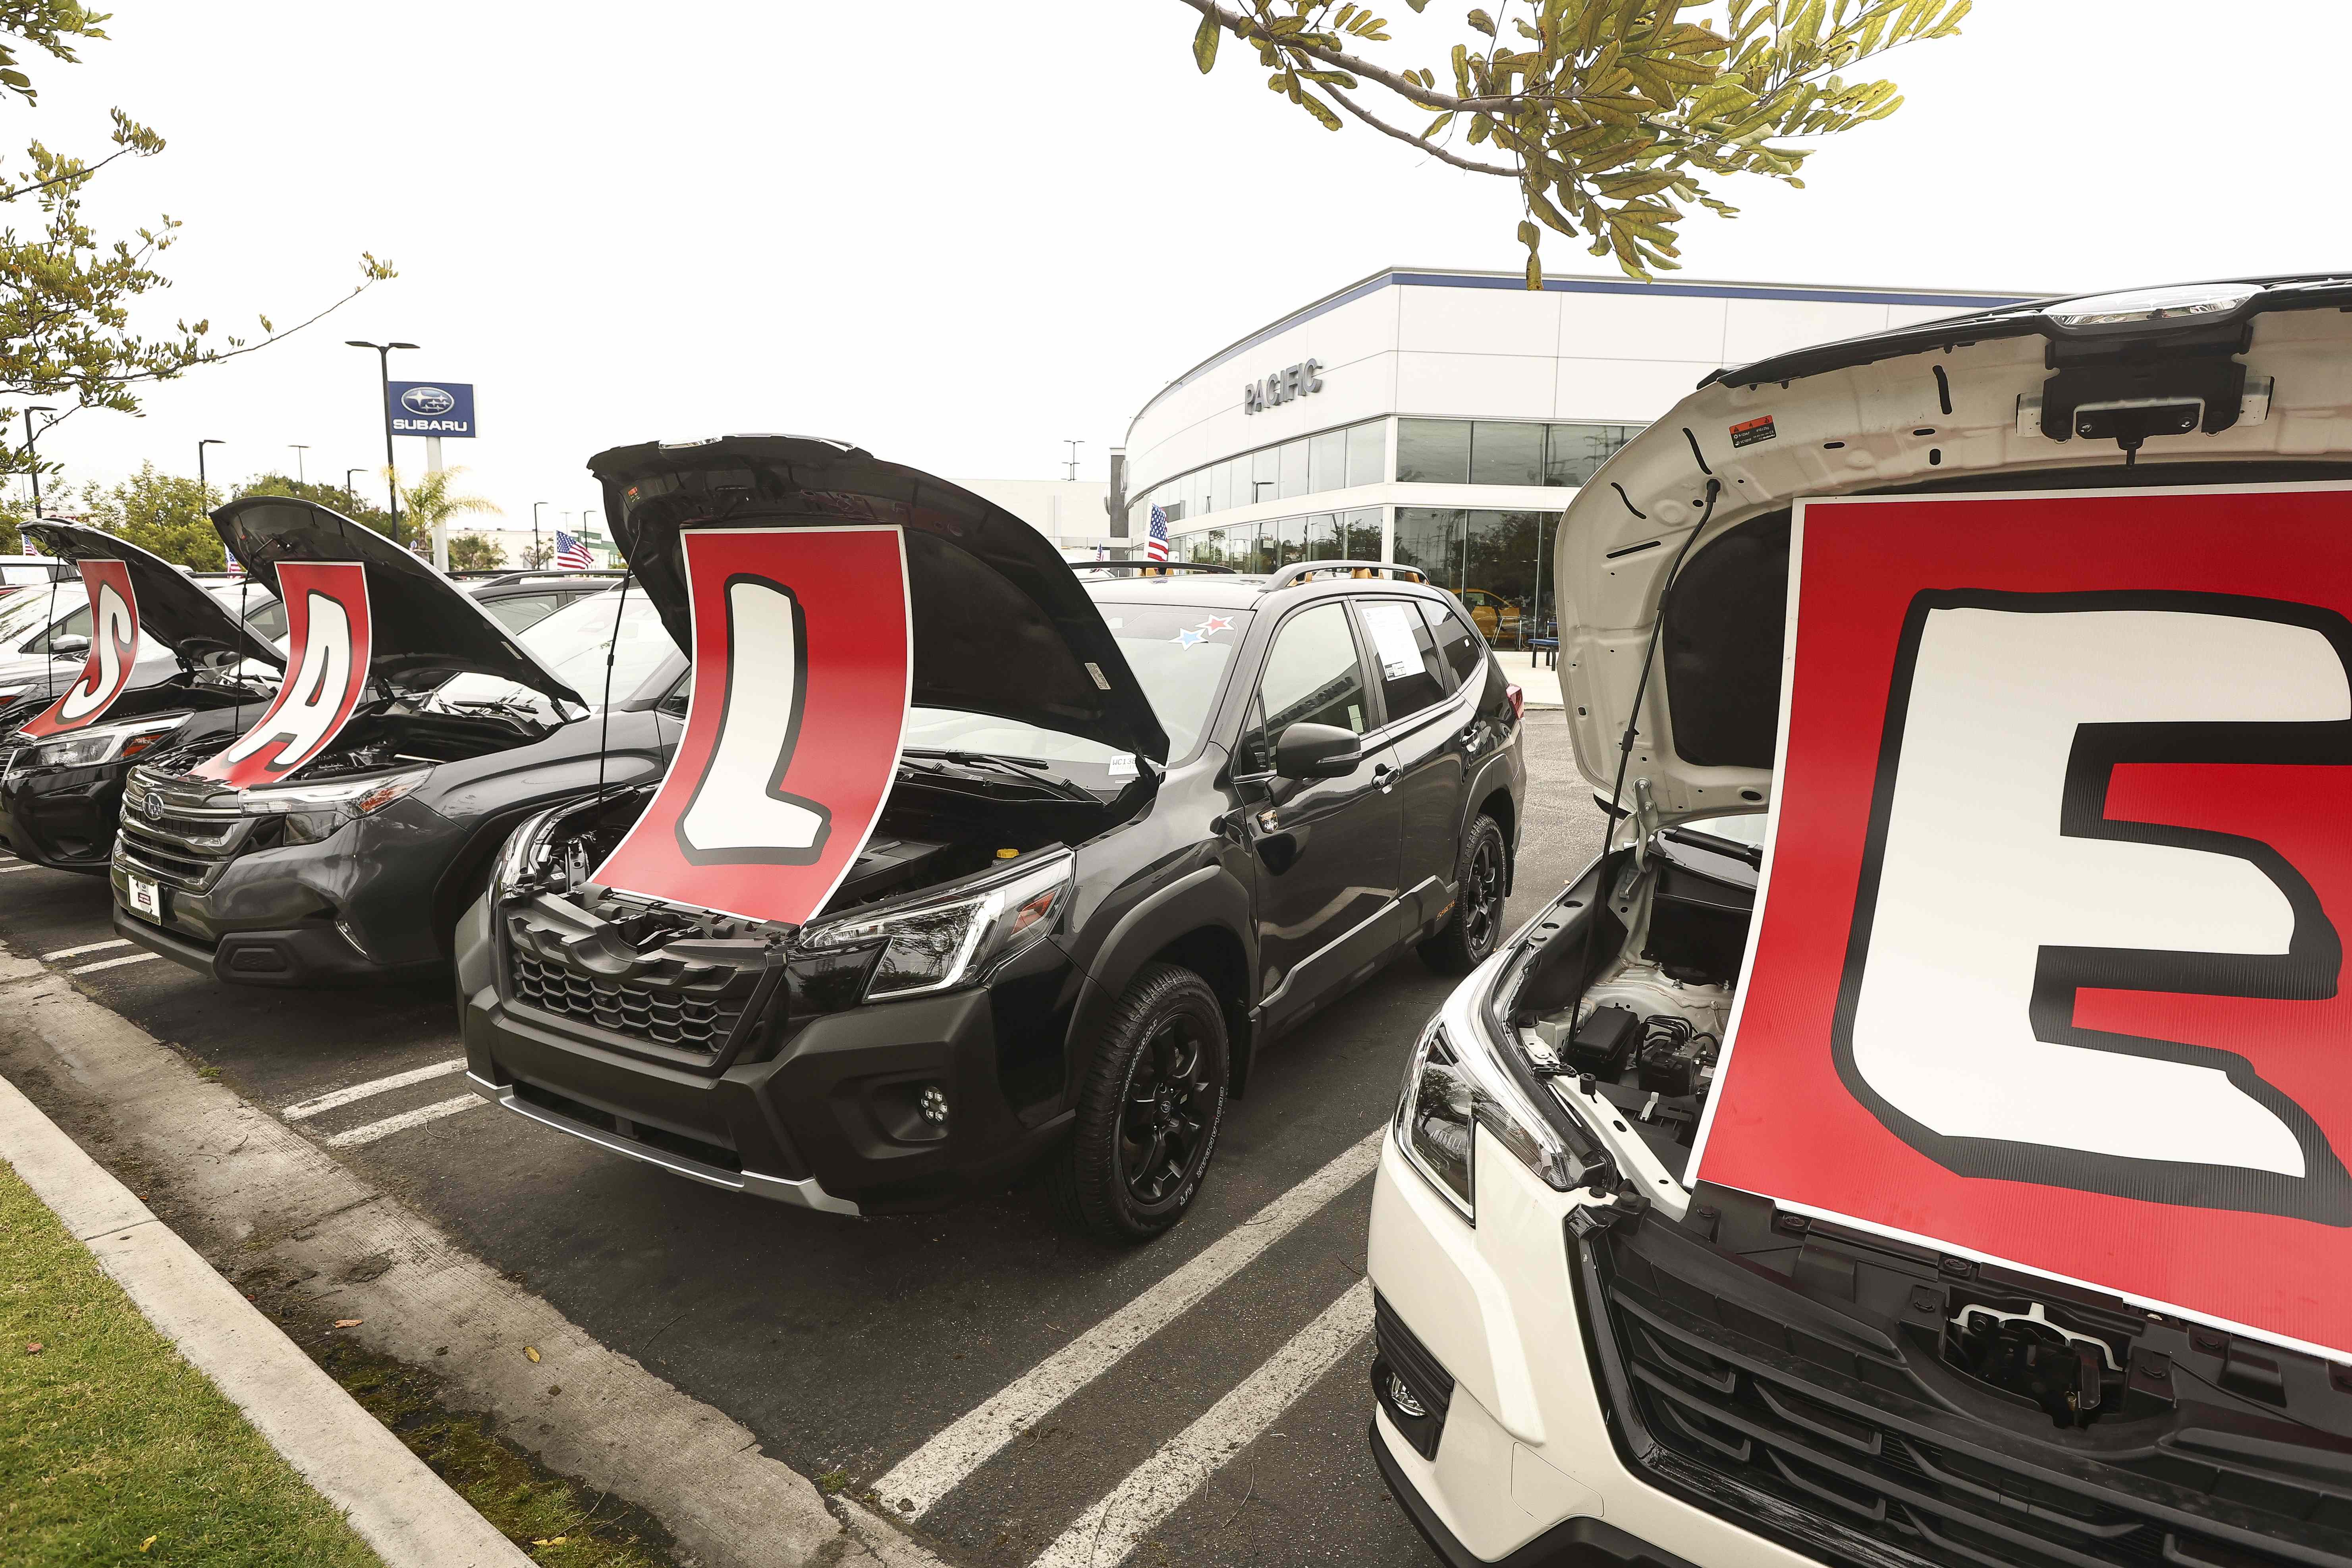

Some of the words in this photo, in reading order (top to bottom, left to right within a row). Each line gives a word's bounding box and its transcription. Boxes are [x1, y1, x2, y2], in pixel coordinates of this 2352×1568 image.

[393, 419, 468, 432] SUBARU
[1244, 358, 1324, 415] PACIFIC
[56, 579, 135, 725] S
[221, 588, 352, 772] A
[674, 572, 832, 866] L
[1831, 588, 2352, 1228] E
[1121, 1019, 1157, 1103] YOKOHAMA
[1196, 1086, 1224, 1178] GEOLANDAR
[1180, 1183, 1193, 1206] A/T
